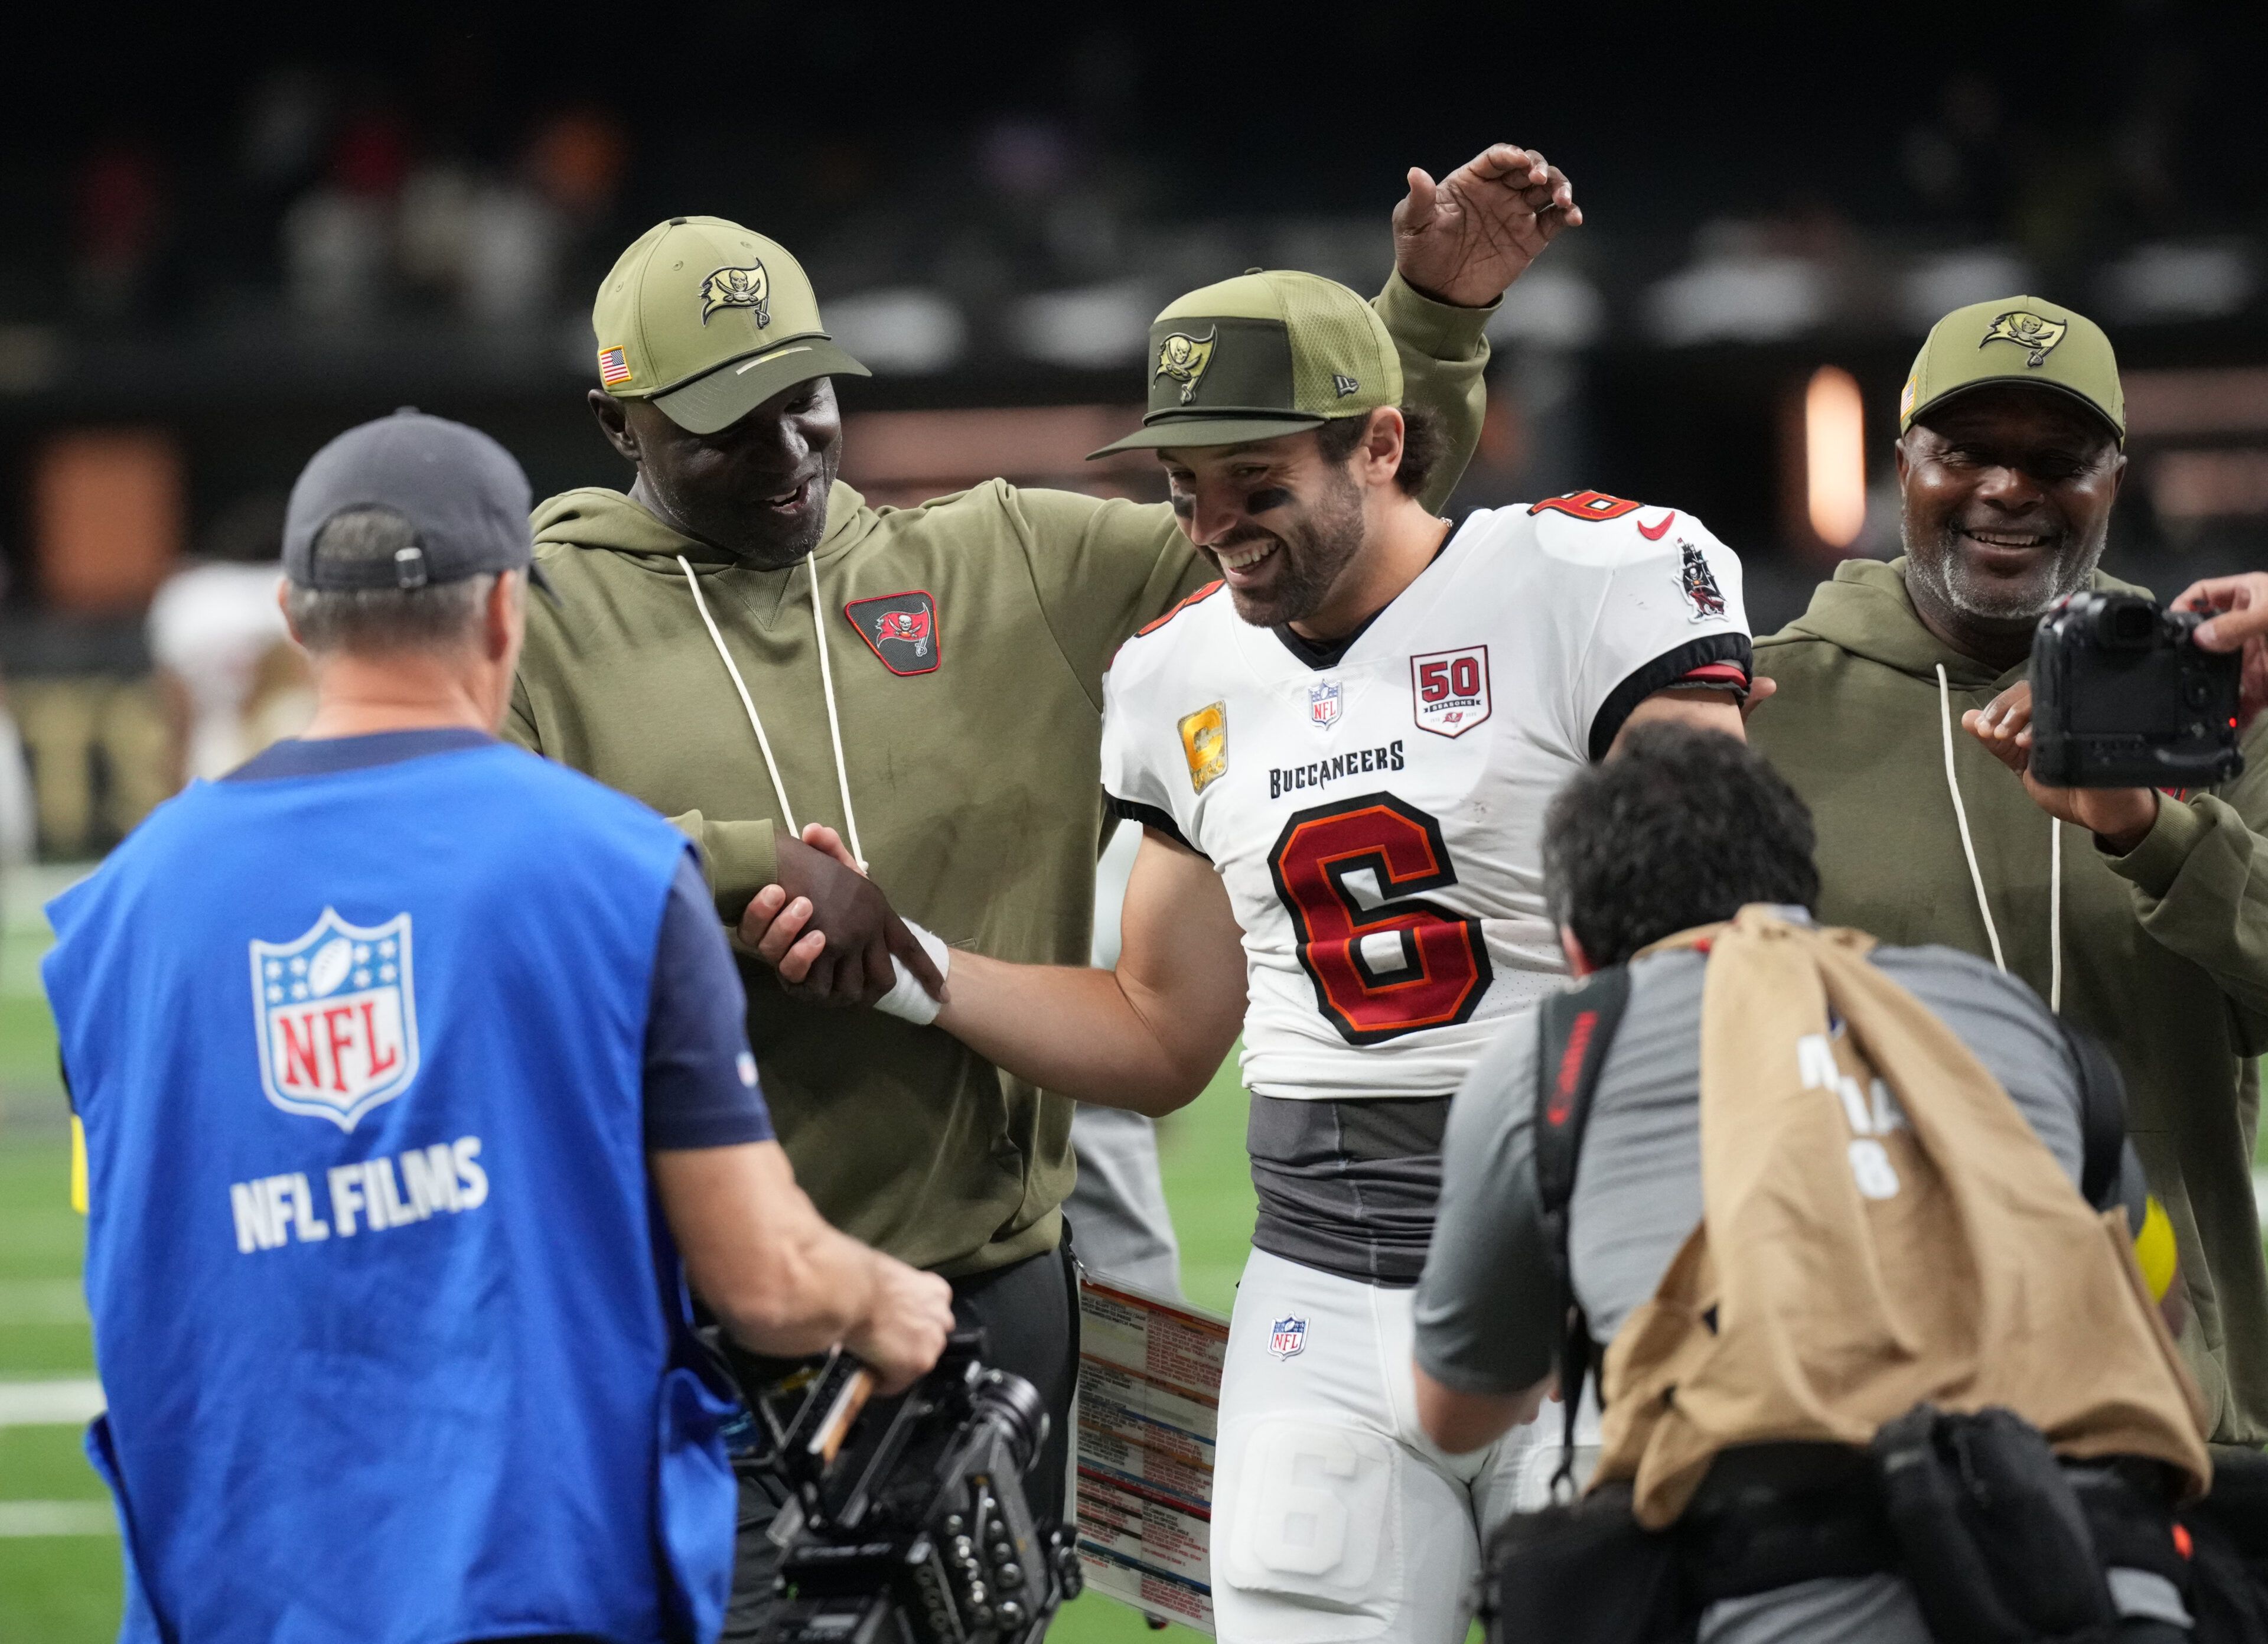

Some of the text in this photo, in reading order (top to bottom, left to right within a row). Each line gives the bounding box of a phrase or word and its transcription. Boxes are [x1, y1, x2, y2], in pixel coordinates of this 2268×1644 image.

[1314, 701, 1336, 720] NFL
[1420, 656, 1480, 703] 50
[1432, 700, 1472, 711] SEASONS
[1184, 708, 1223, 772] C
[1267, 790, 1494, 1045] 6
[279, 1001, 397, 1093] NFL
[230, 1135, 490, 1254] NFL FILMS
[1274, 1334, 1298, 1351] NFL
[1254, 1428, 1357, 1576] 6
